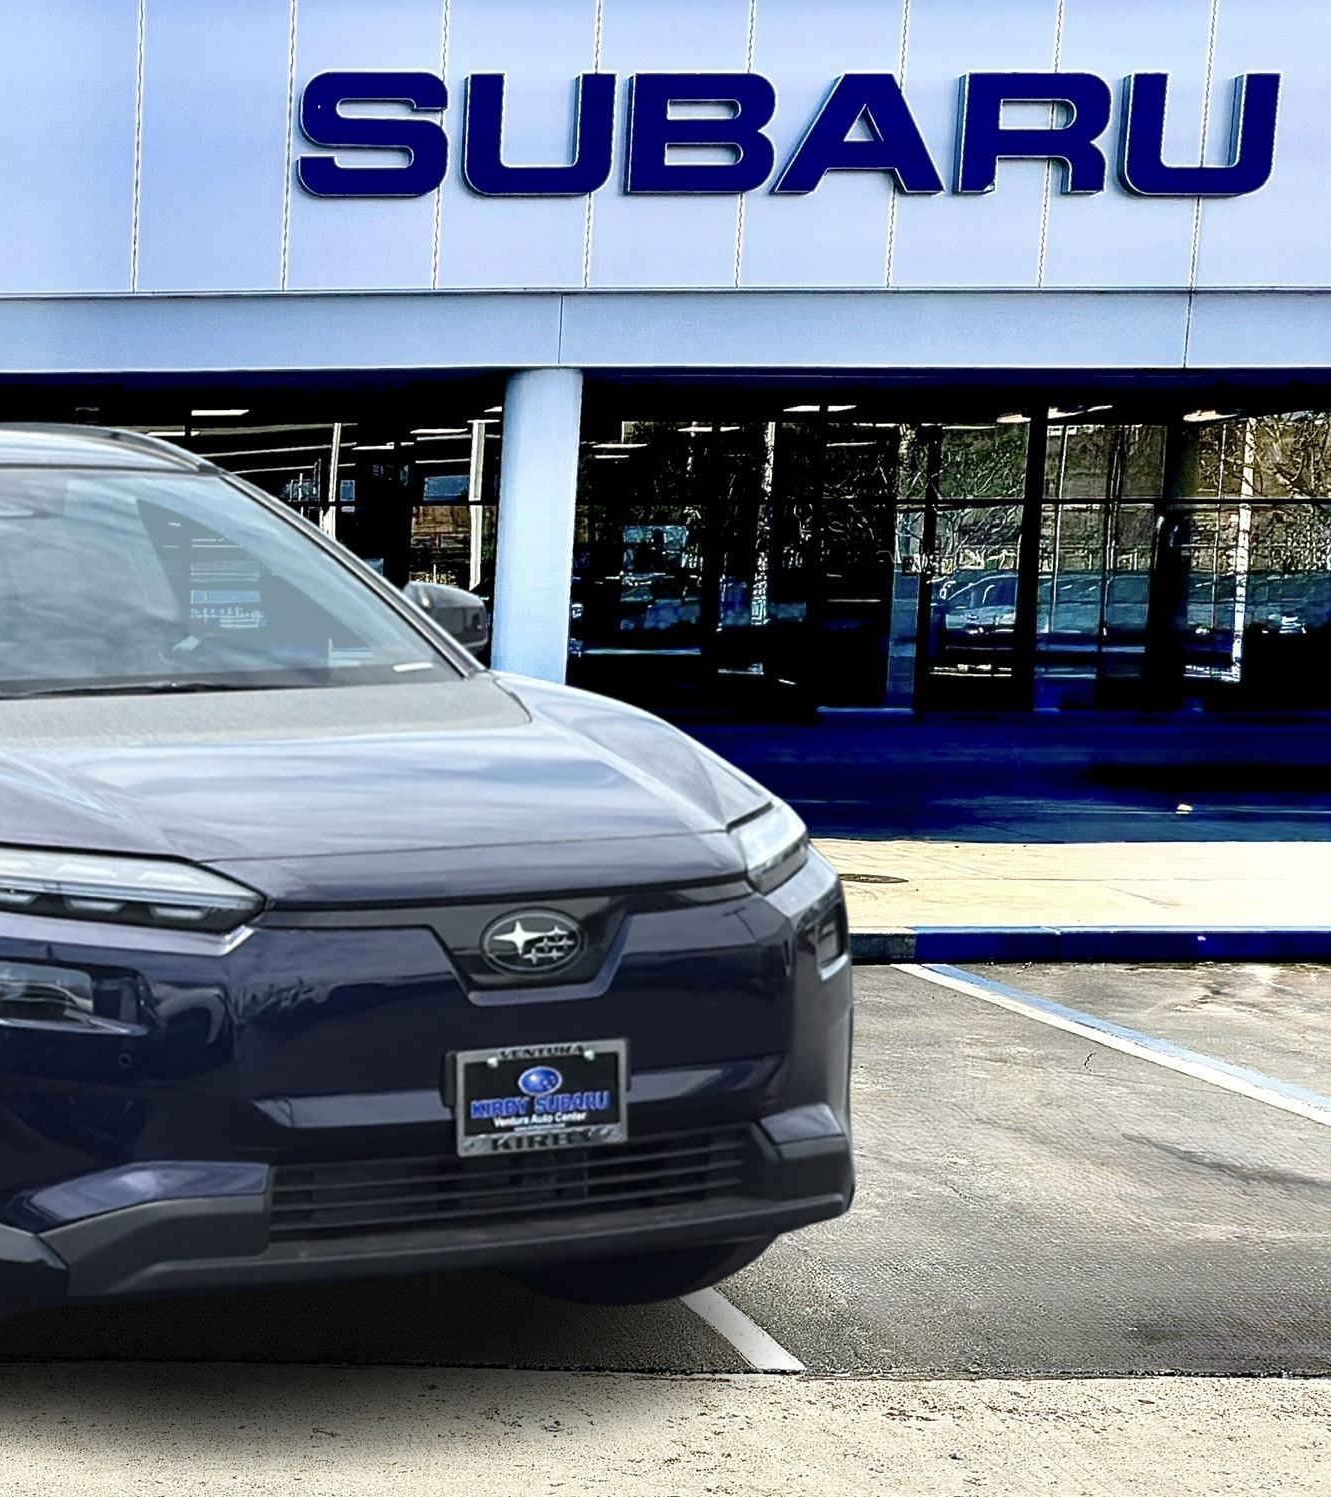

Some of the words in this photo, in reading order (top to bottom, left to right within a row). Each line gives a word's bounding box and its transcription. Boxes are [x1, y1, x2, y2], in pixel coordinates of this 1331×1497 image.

[297, 71, 1281, 198] SUBARU
[500, 1045, 584, 1059] VENTURA
[472, 1097, 530, 1119] KIRBY
[535, 1091, 609, 1114] SUBARU
[493, 1116, 529, 1128] Ventura
[531, 1114, 552, 1124] Auto
[555, 1112, 587, 1122] Center
[492, 1131, 592, 1151] KIRBY
